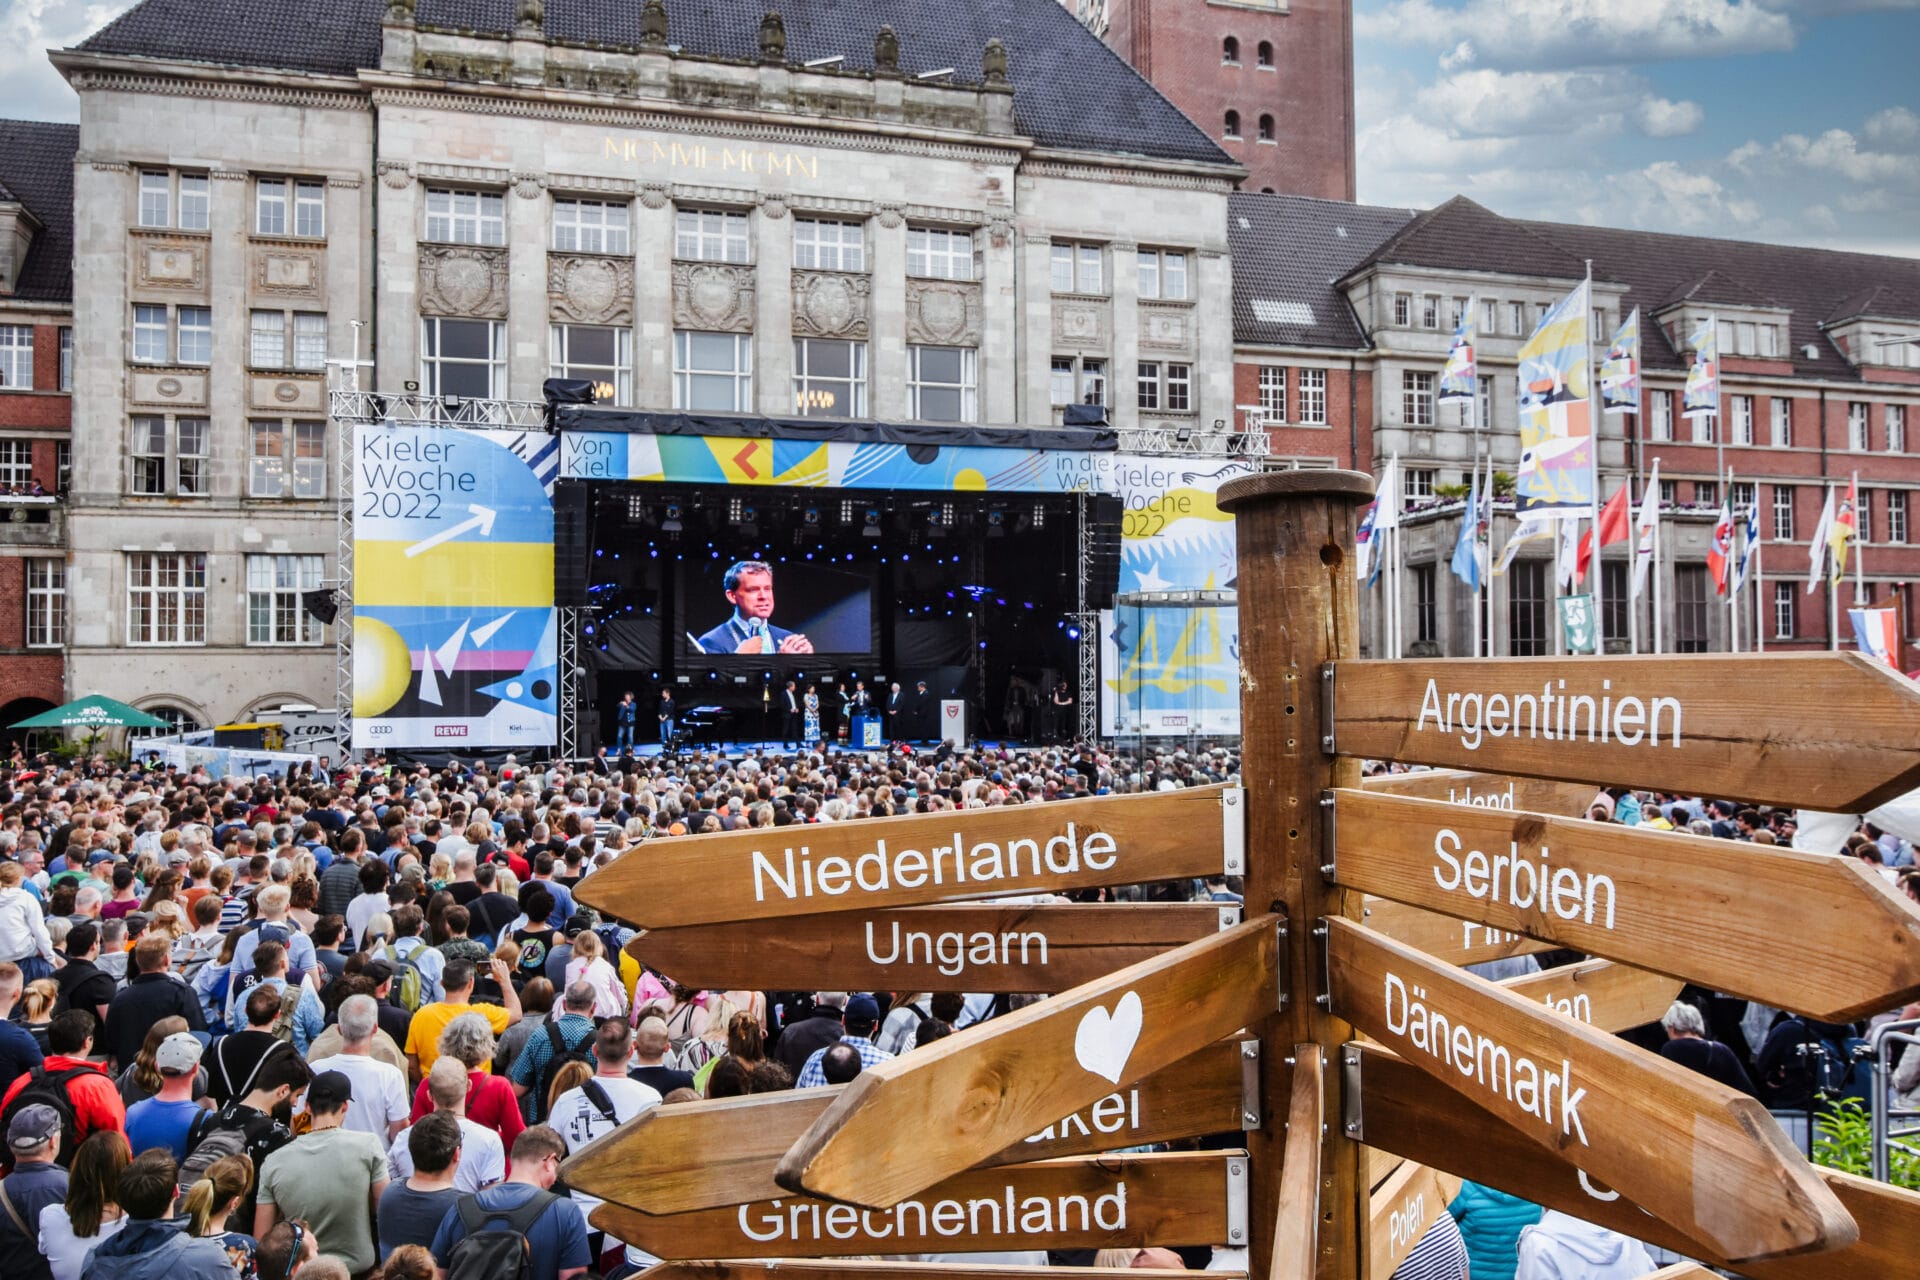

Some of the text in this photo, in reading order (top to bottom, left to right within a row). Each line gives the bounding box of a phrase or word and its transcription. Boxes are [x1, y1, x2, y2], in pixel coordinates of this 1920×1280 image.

[362, 433, 456, 463] Kieler
[567, 434, 612, 456] Von
[567, 456, 612, 477] Kiel
[1056, 452, 1110, 473] in die
[361, 463, 476, 493] Woche
[1056, 472, 1104, 491] Welt
[362, 491, 442, 519] 2022
[1122, 513, 1165, 537] 022
[61, 717, 124, 725] HOLSTEN
[1416, 679, 1683, 750] Argentinien
[435, 726, 468, 736] REWE
[751, 821, 1118, 902] Niederlande
[1433, 828, 1617, 930] Serbien
[865, 921, 1048, 976] Ungarn
[1384, 972, 1590, 1147] Dänemark
[737, 1181, 1127, 1242] Griechenland
[1389, 1192, 1424, 1259] Polen
